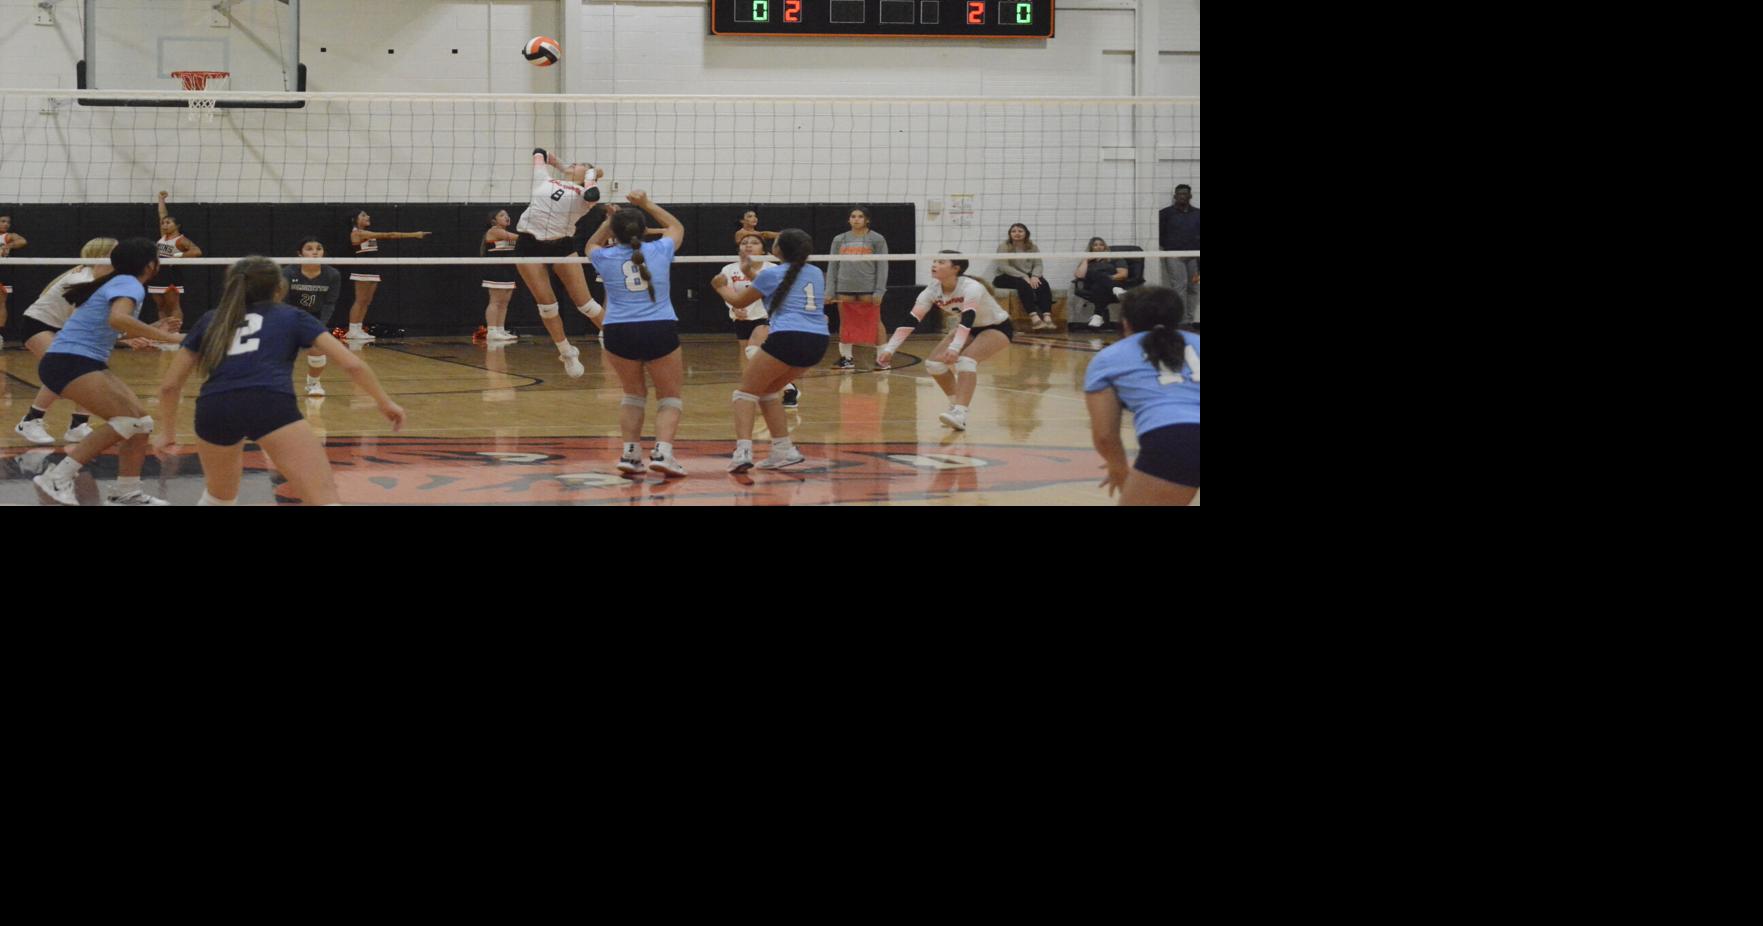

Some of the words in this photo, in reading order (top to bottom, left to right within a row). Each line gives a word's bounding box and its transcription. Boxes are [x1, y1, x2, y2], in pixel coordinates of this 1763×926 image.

[753, 0, 768, 21] 0
[784, 0, 799, 22] 2
[968, 2, 985, 23] 2
[1016, 2, 1031, 24] 0
[551, 189, 565, 202] 8
[621, 260, 649, 292] 8
[299, 293, 316, 307] 21
[803, 282, 817, 311] 1
[227, 313, 264, 356] 2
